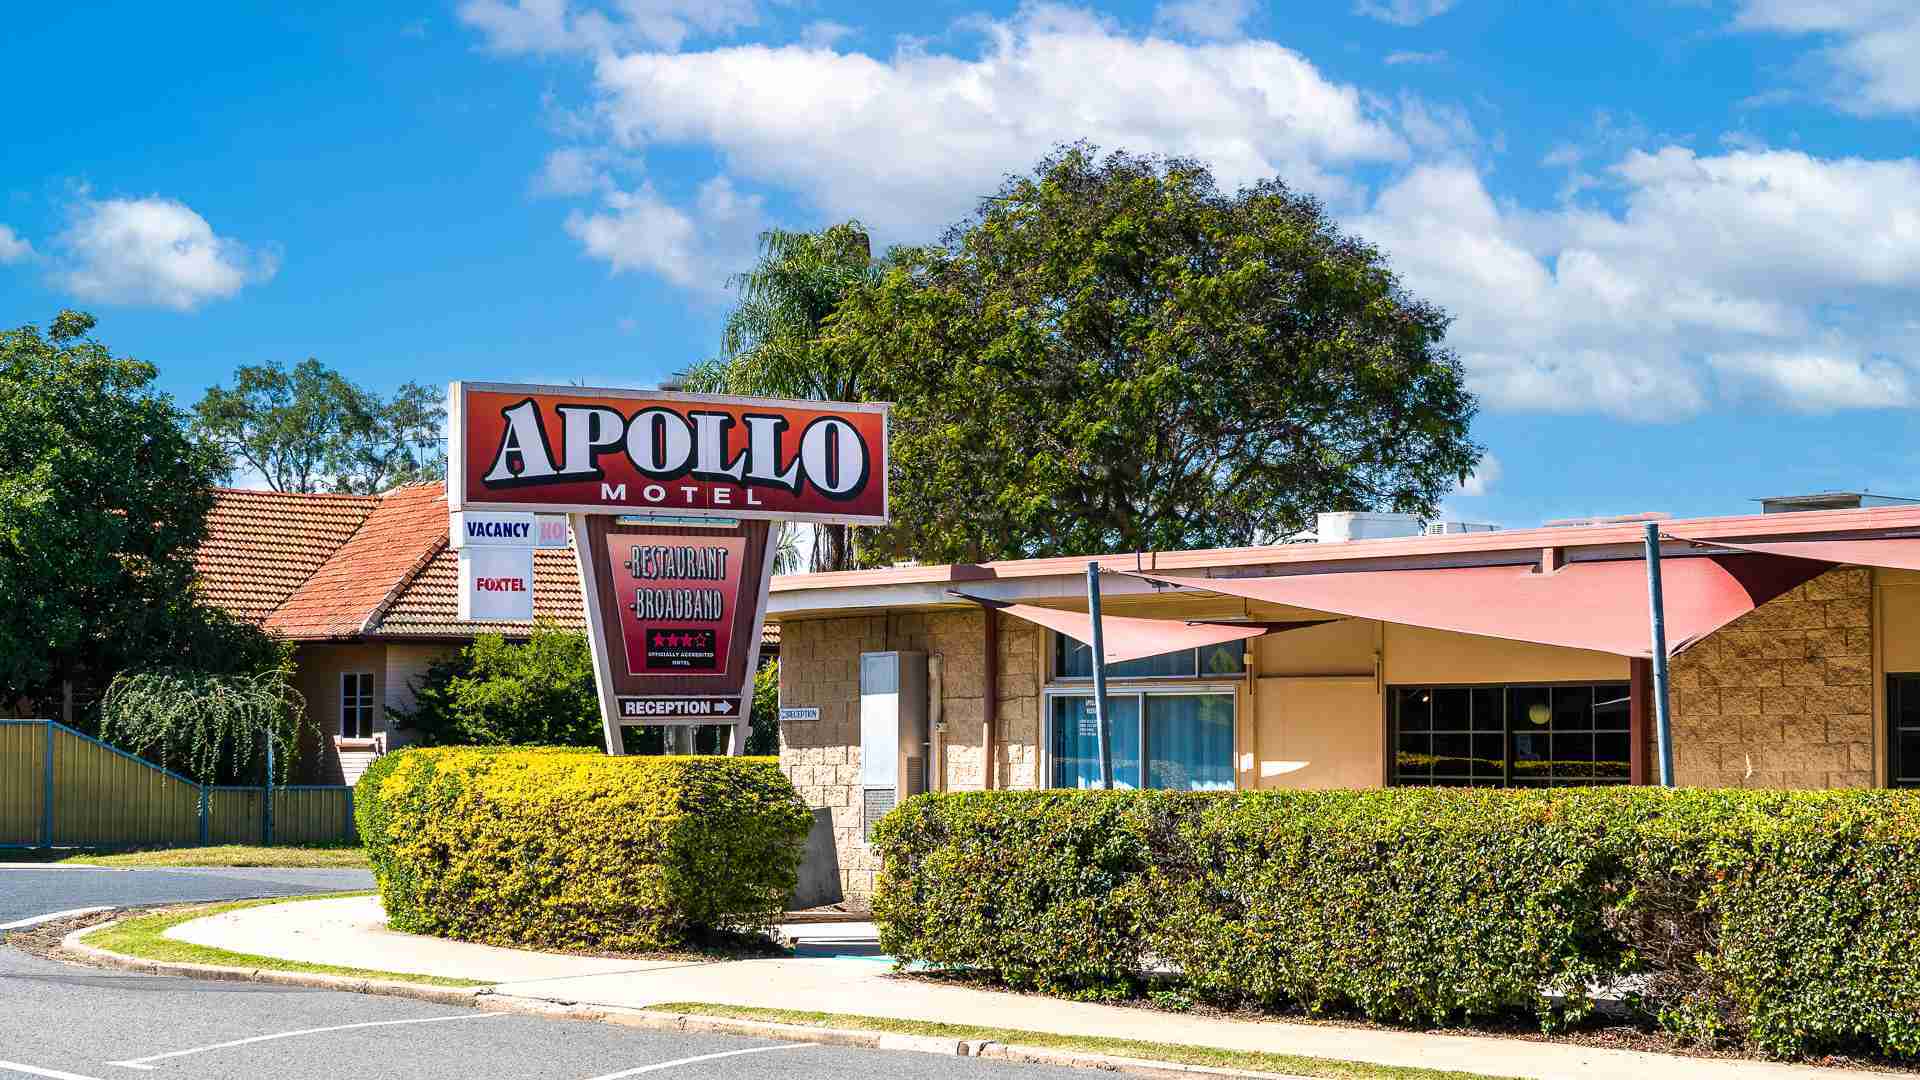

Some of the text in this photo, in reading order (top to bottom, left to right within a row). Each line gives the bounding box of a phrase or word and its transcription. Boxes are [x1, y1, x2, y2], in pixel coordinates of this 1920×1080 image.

[482, 397, 870, 498] APOLLO
[601, 483, 761, 505] MOTEL
[467, 522, 561, 538] VACANCY NO
[476, 578, 526, 591] FOXTEL
[625, 702, 711, 714] RECEPTION
